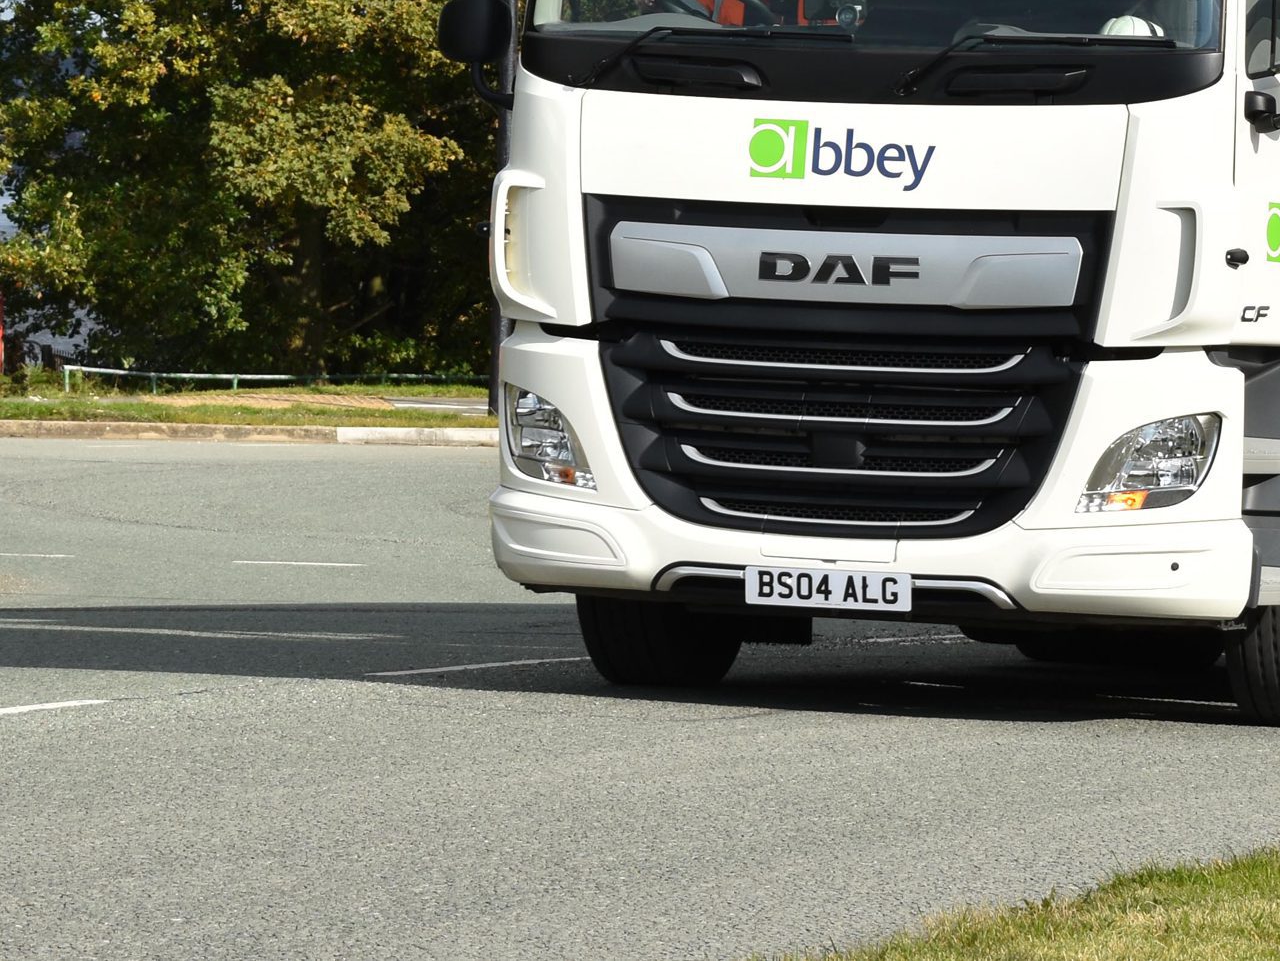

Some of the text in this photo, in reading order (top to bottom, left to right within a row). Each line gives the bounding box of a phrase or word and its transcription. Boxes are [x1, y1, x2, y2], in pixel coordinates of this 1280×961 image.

[749, 118, 937, 191] abbey
[758, 251, 920, 286] DAF
[1240, 305, 1270, 323] CF
[758, 570, 899, 605] BS04 ALG
